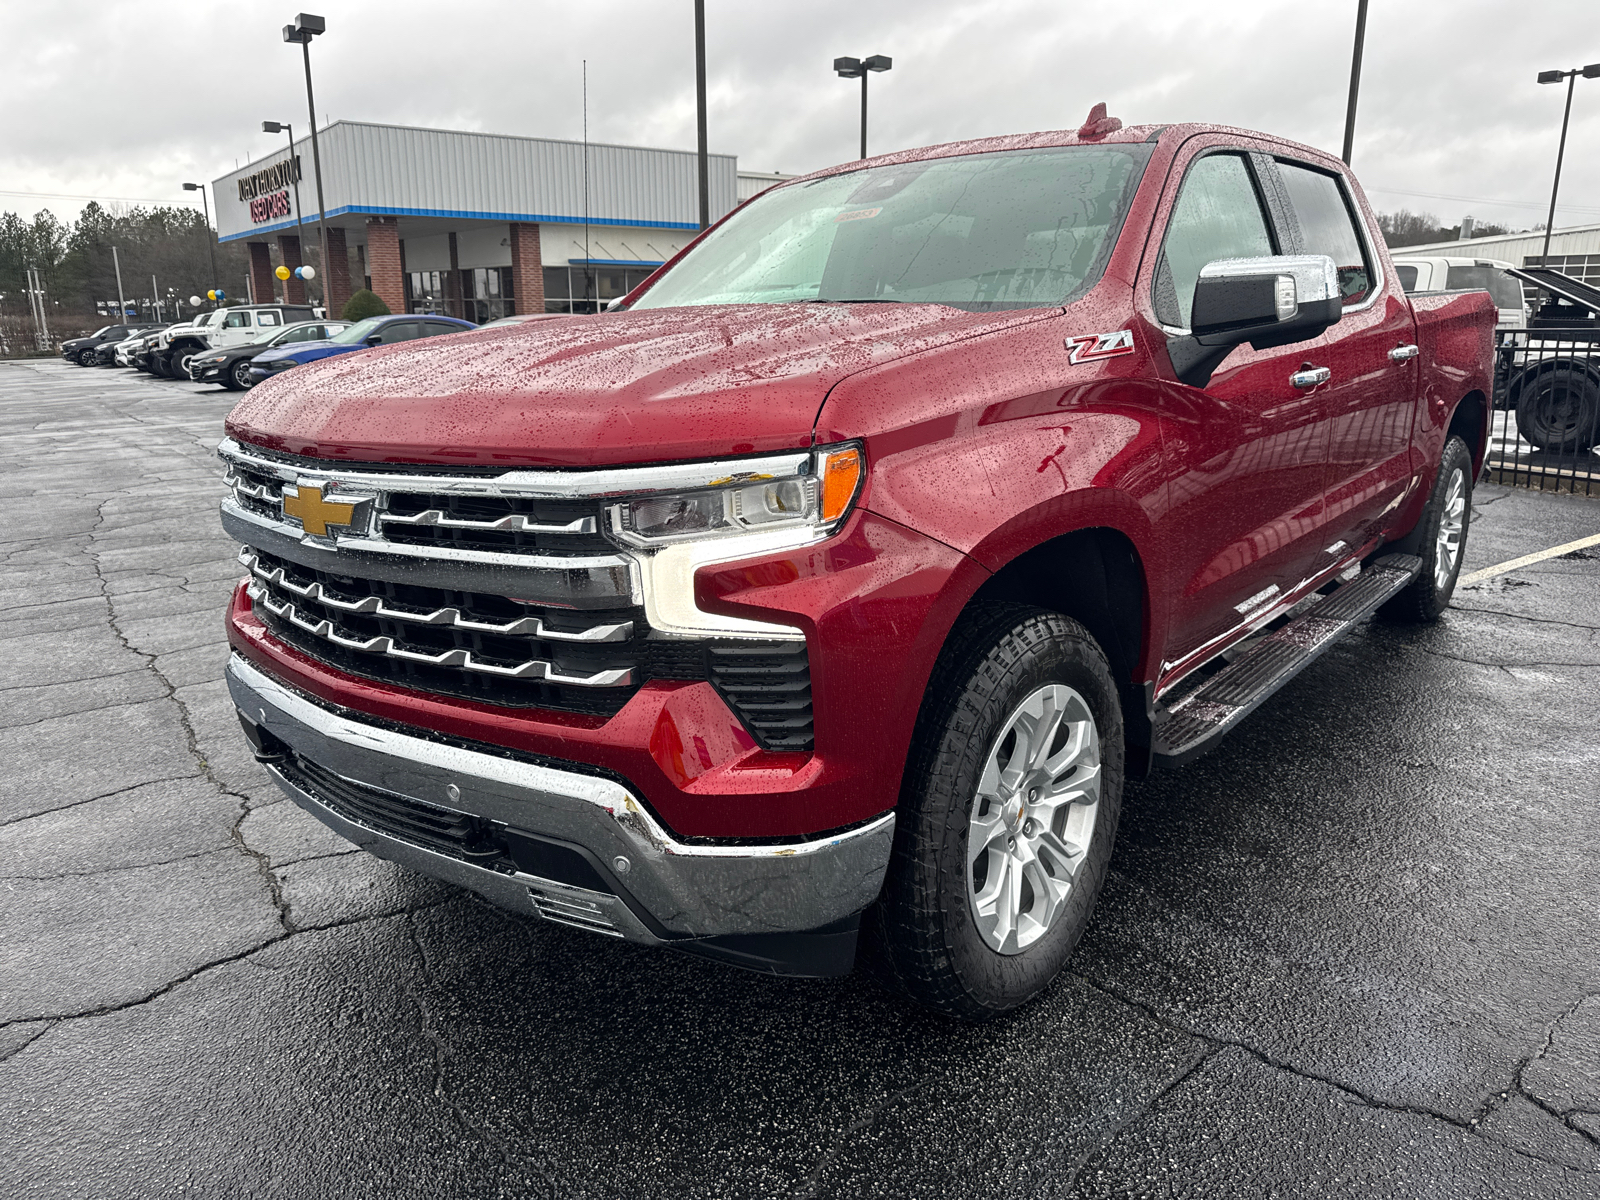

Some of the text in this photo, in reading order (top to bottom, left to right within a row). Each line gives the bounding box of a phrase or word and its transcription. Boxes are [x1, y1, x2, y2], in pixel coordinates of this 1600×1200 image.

[237, 155, 302, 202] JOHN THORNTON
[249, 190, 291, 223] USED CARS
[1064, 329, 1135, 366] Z71
